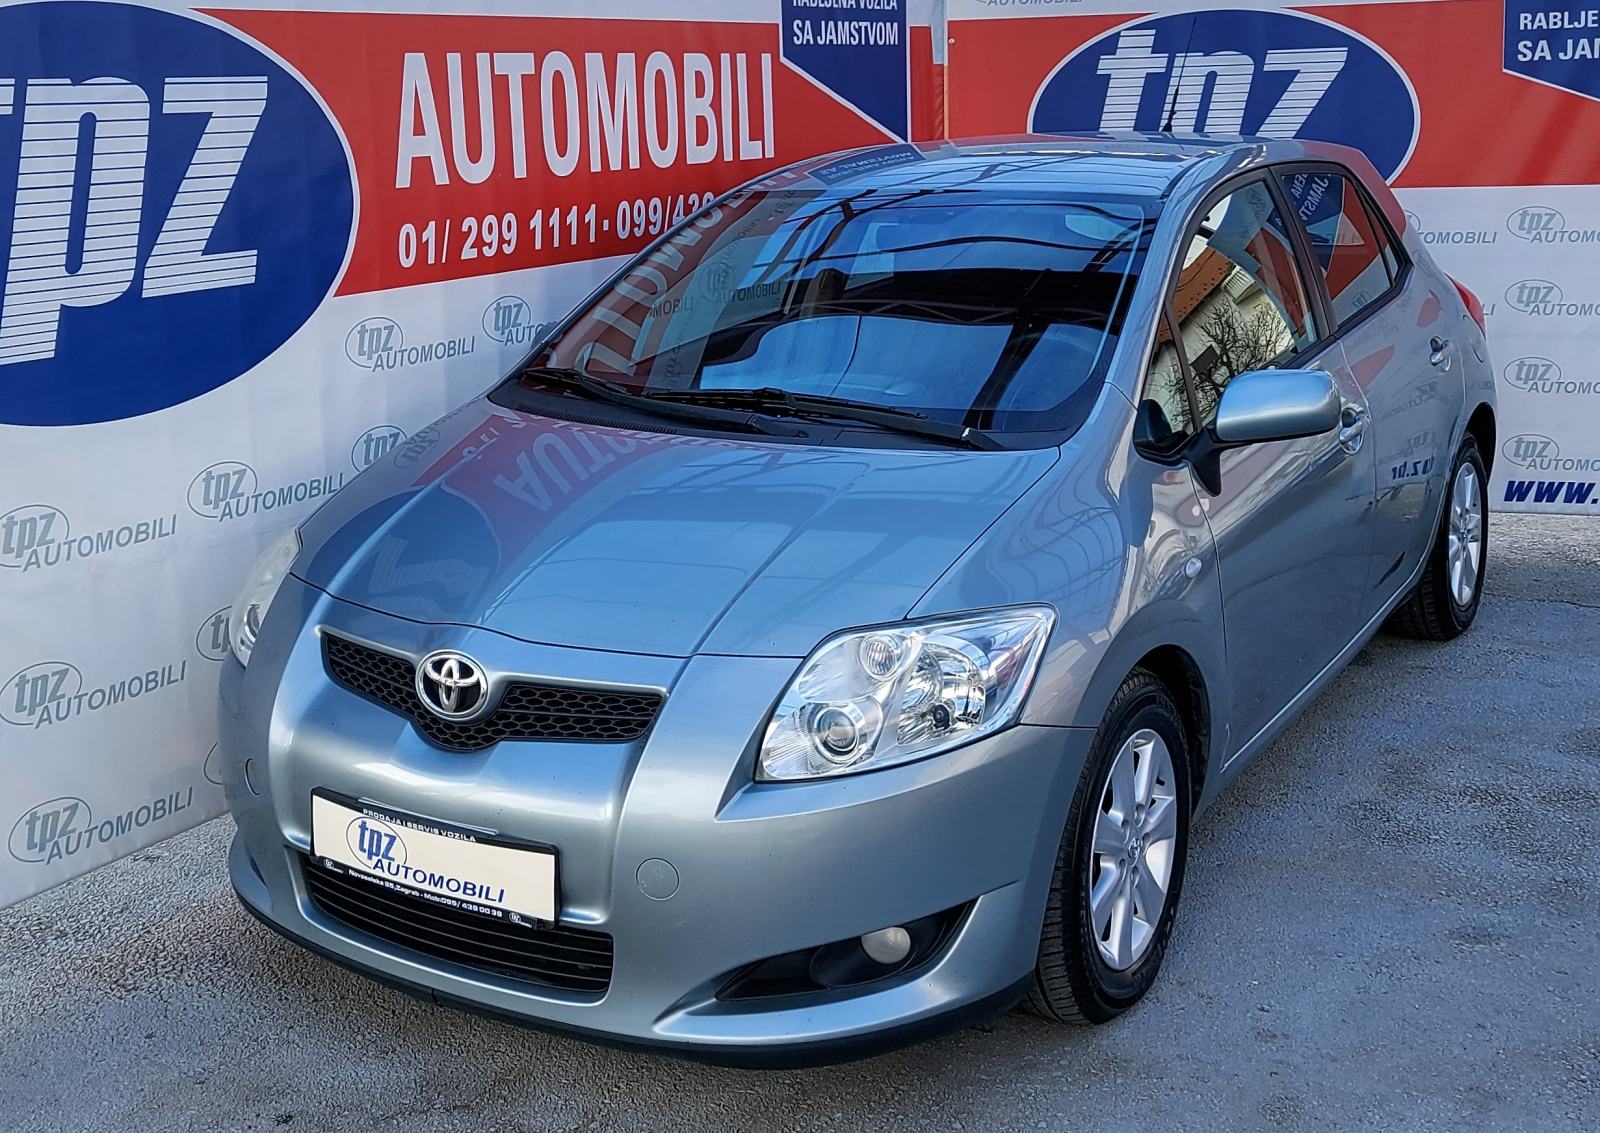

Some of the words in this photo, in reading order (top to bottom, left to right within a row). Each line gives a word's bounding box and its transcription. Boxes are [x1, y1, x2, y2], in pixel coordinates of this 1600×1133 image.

[793, 19, 814, 45] SA
[816, 20, 899, 45] JAMSTVOM
[1519, 10, 1599, 31] RABLJE
[1517, 39, 1552, 62] SA
[394, 51, 775, 189] AUTOMOBILI
[0, 75, 269, 366] pz
[460, 212, 518, 261] 299
[1517, 209, 1558, 235] tpz
[1529, 229, 1600, 244] AUTOM
[1516, 282, 1556, 308] tpz
[493, 301, 524, 336] tpz
[356, 321, 396, 367] tpz
[371, 336, 476, 373] AUTOMOBILI
[1514, 359, 1554, 385] tpz
[1512, 436, 1552, 462] tpz
[201, 468, 248, 511] tpz
[218, 472, 345, 522] AUTOMOBILI
[1, 512, 57, 562] tpz
[22, 513, 178, 573] AUTOMOBILI
[14, 669, 71, 719] tpz
[34, 659, 187, 729] AUTOMOBILI
[24, 801, 80, 855] tpz
[46, 786, 194, 866] AUTOMOBILI
[358, 819, 397, 862] tpz
[362, 807, 402, 826] PRODAJA
[407, 822, 440, 836] SERVIS
[440, 828, 477, 843] VOZILA
[372, 858, 505, 904] AUTOMOBILI
